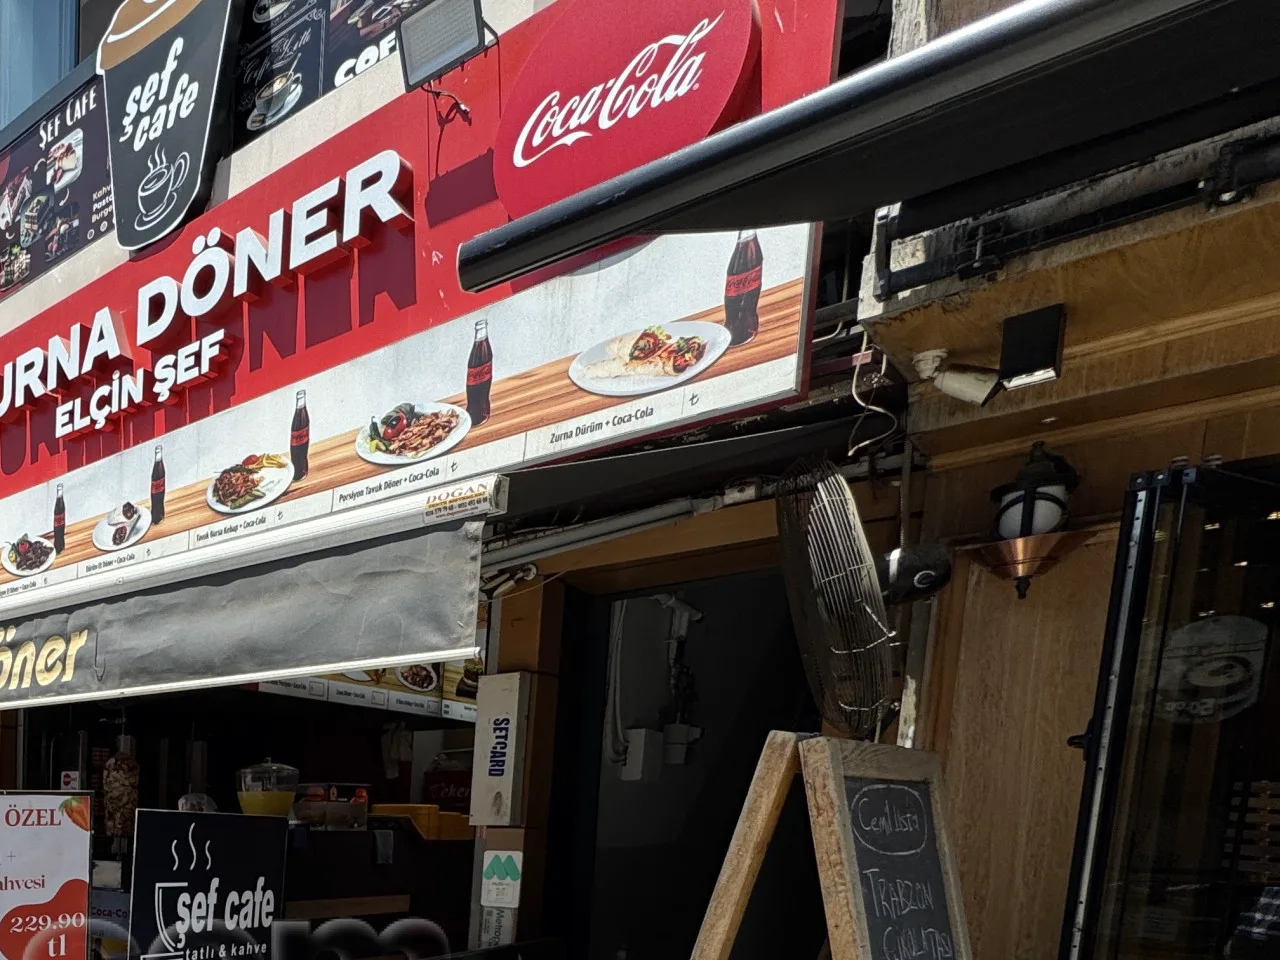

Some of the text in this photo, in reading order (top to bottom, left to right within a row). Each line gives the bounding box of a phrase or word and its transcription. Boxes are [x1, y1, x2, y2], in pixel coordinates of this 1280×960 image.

[334, 30, 400, 88] COF
[119, 37, 183, 143] şef
[133, 72, 199, 152] cafe
[513, 10, 724, 168] Coca-Cola
[91, 206, 113, 223] Burge
[92, 184, 111, 201] Kahv
[136, 148, 405, 348] DÖNER
[55, 328, 226, 439] ELÇİN ŞEF
[550, 427, 573, 444] Zurna
[574, 419, 603, 438] Dürüm
[612, 405, 654, 427] Coca-Cola
[487, 717, 511, 778] SETCARD
[4, 804, 62, 828] ÖZEL
[175, 876, 275, 949] şef cafe
[862, 868, 933, 919] TRABZON
[9, 911, 86, 934] 229.90
[47, 934, 67, 957] tl
[219, 943, 227, 958] &
[231, 941, 267, 957] kahve
